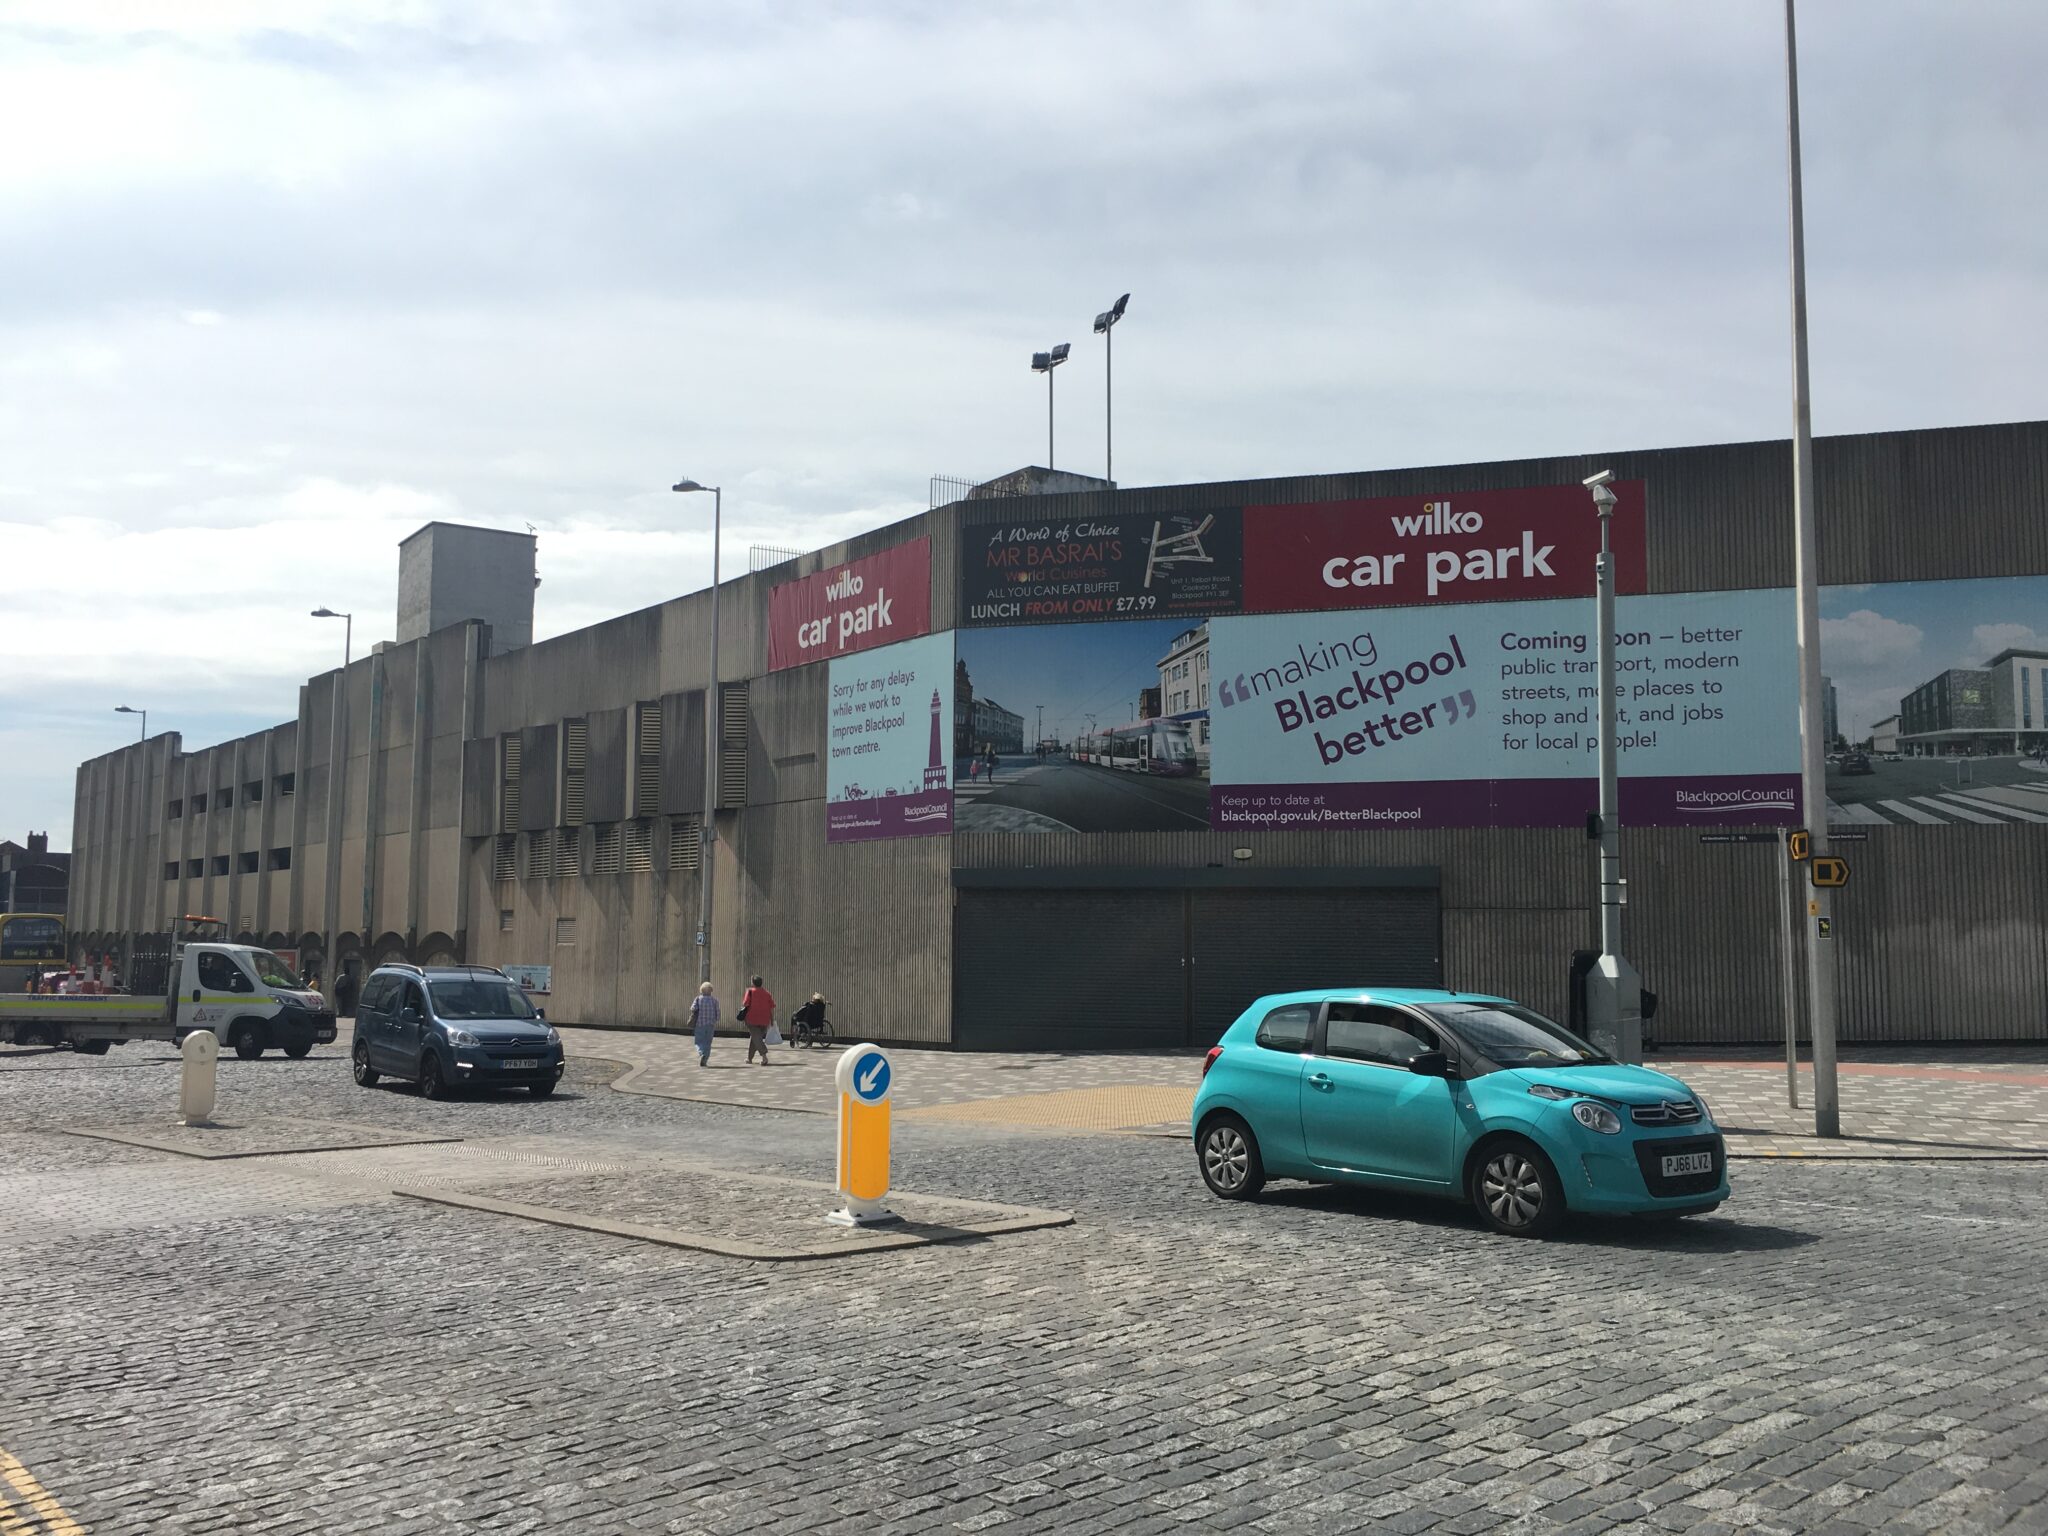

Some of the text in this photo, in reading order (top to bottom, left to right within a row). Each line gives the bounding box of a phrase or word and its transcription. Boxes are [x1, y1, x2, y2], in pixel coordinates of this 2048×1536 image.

[1391, 502, 1483, 537] wilko
[988, 523, 1120, 547] A World of Choice
[987, 541, 1122, 568] MR BASRAI'S
[1322, 530, 1556, 596] car park
[826, 569, 863, 603] wilko
[1051, 567, 1107, 582] Cuisines
[987, 582, 1120, 599] ALL YOU CAN EAT BUFFET
[798, 587, 893, 649] car park
[971, 595, 1156, 618] LUNCH FROM ONLY £7.99
[1500, 630, 1587, 654] Coming
[1681, 626, 1743, 644] better
[1501, 657, 1556, 680] public
[1664, 651, 1739, 670] modern
[833, 669, 915, 698] Sorry for any delays
[1274, 634, 1467, 733] Blackpool
[1502, 679, 1723, 701] streets, me places to
[832, 694, 901, 717] while we work to
[1502, 708, 1547, 729] shop
[1554, 707, 1588, 724] and
[1639, 704, 1674, 722] and
[1682, 703, 1724, 725] jobs
[832, 711, 905, 740] improve Blackpool
[832, 740, 881, 758] town centre.
[1502, 731, 1657, 753] for local pple!
[1221, 794, 1326, 808] Keep up to date at
[1221, 807, 1421, 824] blackpool.gov.uk/BetterBlackpool
[1666, 1154, 1709, 1173] PJ66 LVZ
